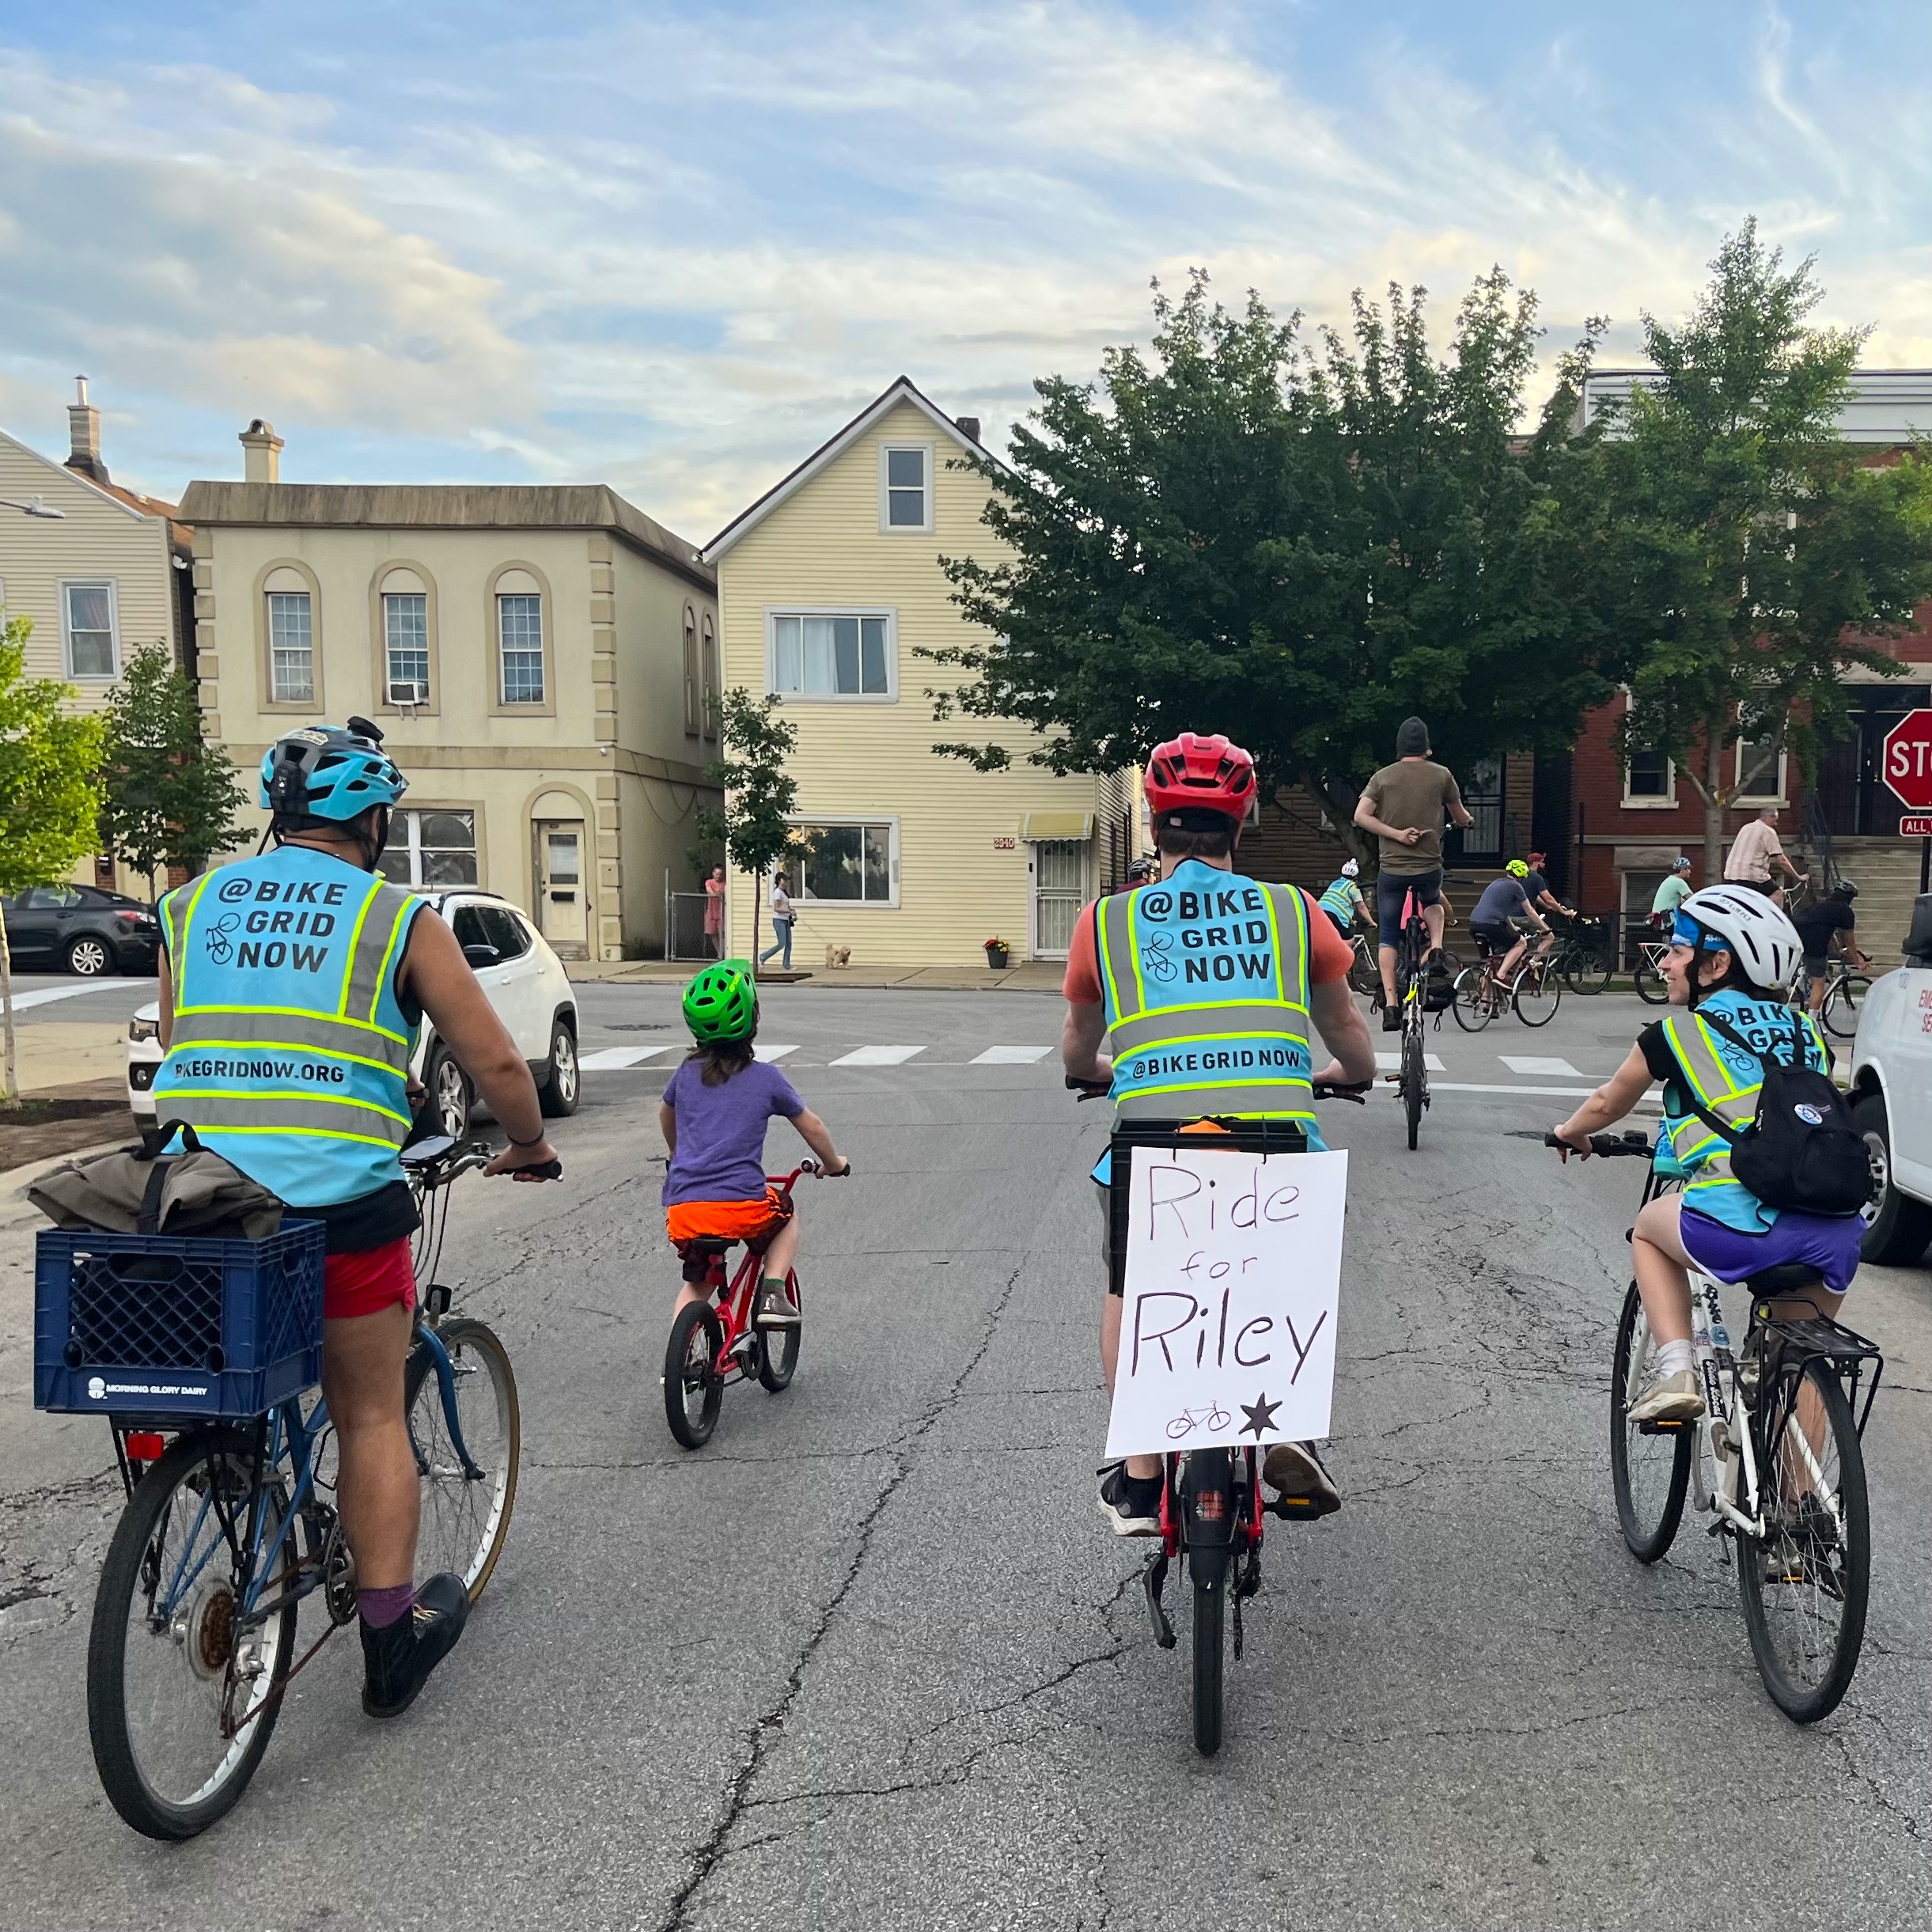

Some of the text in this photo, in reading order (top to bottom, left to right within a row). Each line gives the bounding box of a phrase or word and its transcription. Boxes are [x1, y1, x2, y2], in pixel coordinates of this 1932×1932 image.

[1891, 741, 1932, 778] ST
[1906, 821, 1927, 832] ALL
[218, 878, 348, 906] @BIKE
[1141, 888, 1263, 922] @BIKE
[246, 911, 335, 937] GRID
[1181, 920, 1267, 948] GRID
[237, 941, 329, 972] NOW
[1184, 953, 1270, 983] NOW
[1150, 1165, 1300, 1241] Ride
[1180, 1250, 1258, 1281] for
[1131, 1287, 1328, 1385] Riley
[106, 1385, 207, 1396] MORNING GLORY DAIRY
